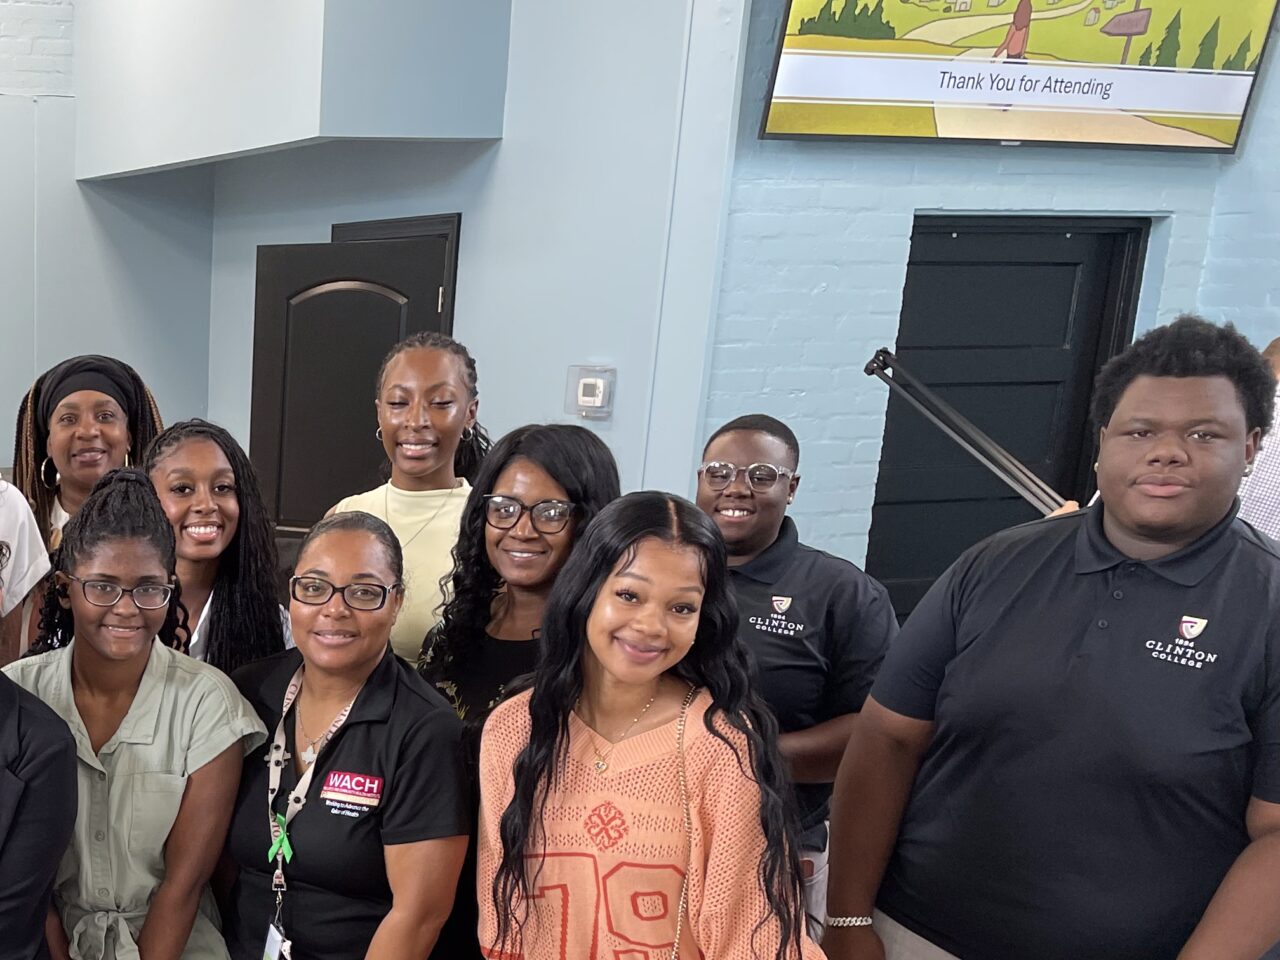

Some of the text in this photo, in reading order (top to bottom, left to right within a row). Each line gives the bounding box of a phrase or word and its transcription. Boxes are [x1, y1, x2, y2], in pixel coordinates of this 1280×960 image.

[939, 71, 1114, 100] Thank You for Attending
[748, 616, 804, 631] CLINTON
[755, 624, 795, 636] COLLEGE
[1145, 640, 1218, 663] CLINTON
[1151, 651, 1203, 669] COLLEGE
[329, 773, 379, 793] WACH
